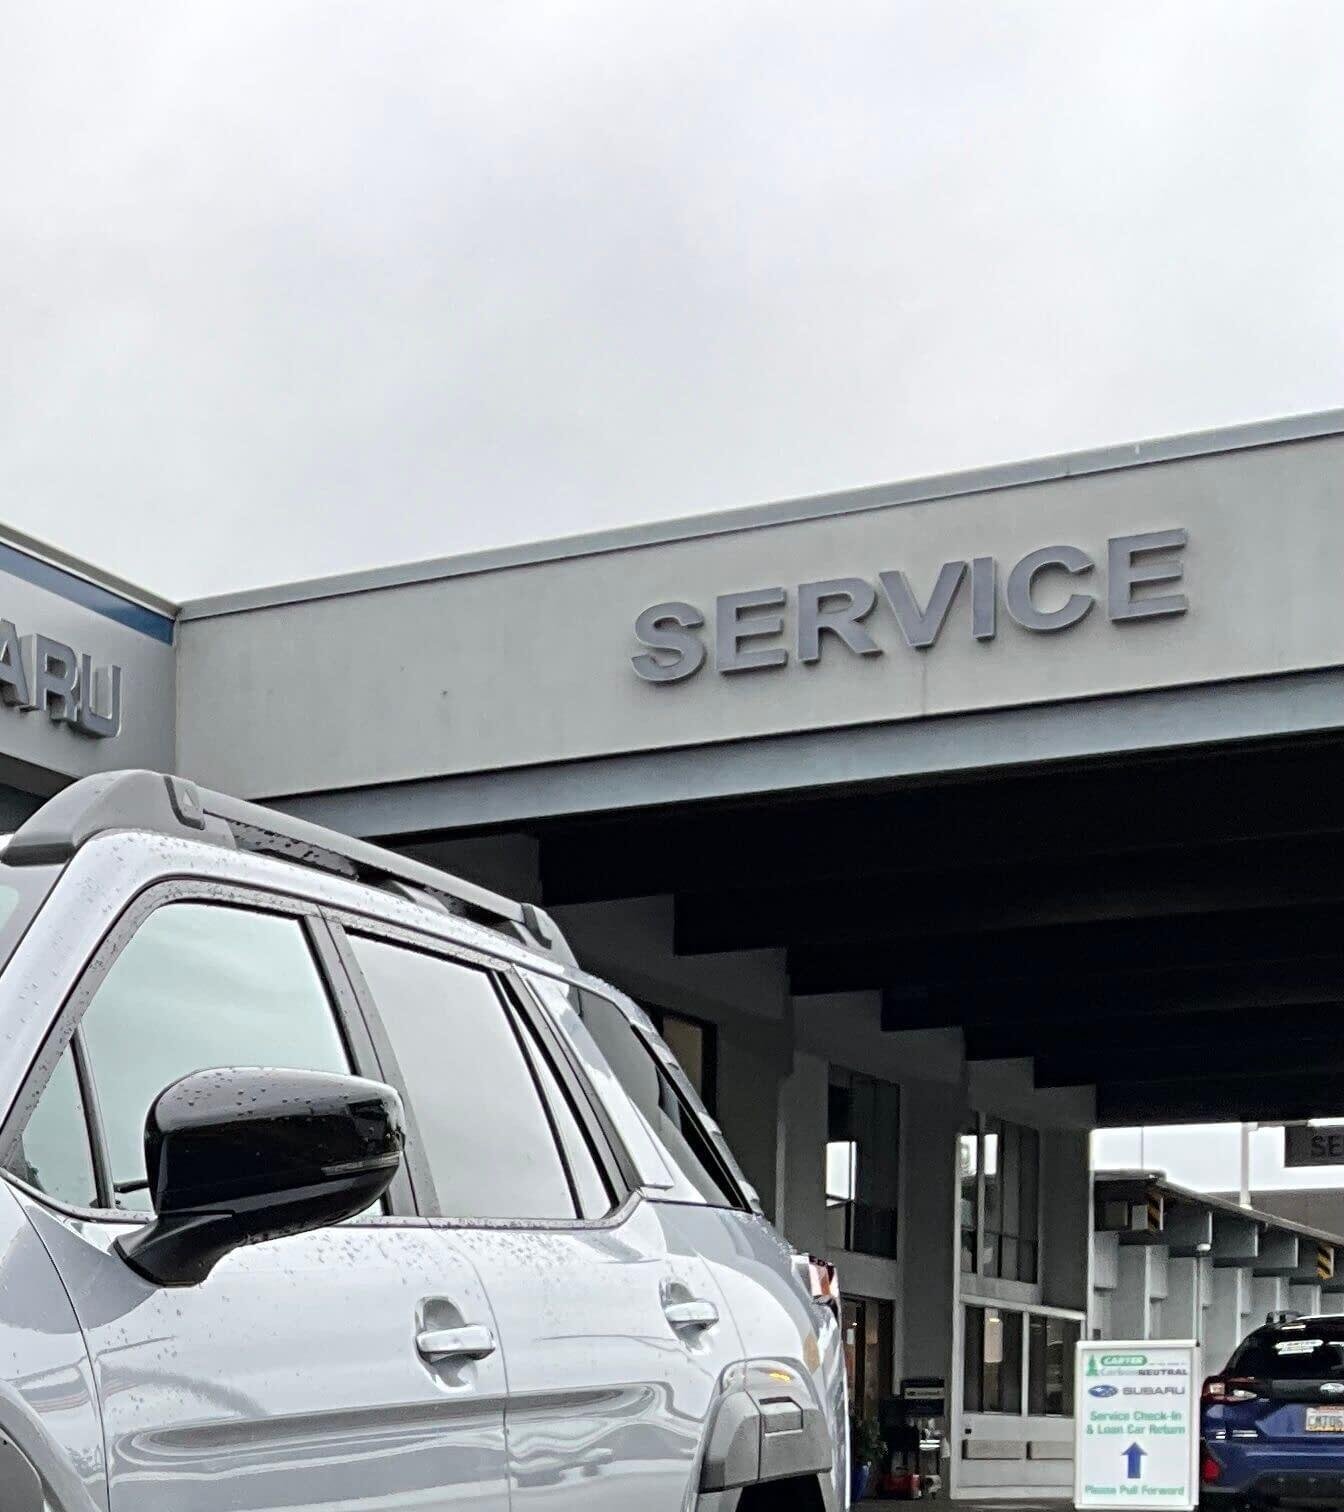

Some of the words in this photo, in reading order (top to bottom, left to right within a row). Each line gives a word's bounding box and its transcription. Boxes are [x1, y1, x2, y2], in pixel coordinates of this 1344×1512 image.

[631, 528, 1188, 684] SERVICE
[1122, 1386, 1185, 1396] SUBARU
[1090, 1410, 1130, 1421] Service
[1086, 1424, 1094, 1434] &
[1097, 1424, 1124, 1434] Loan
[1127, 1424, 1146, 1434] Car
[1149, 1424, 1185, 1434] Return
[1120, 1485, 1138, 1495] Pull
[1141, 1485, 1184, 1495] Forward
